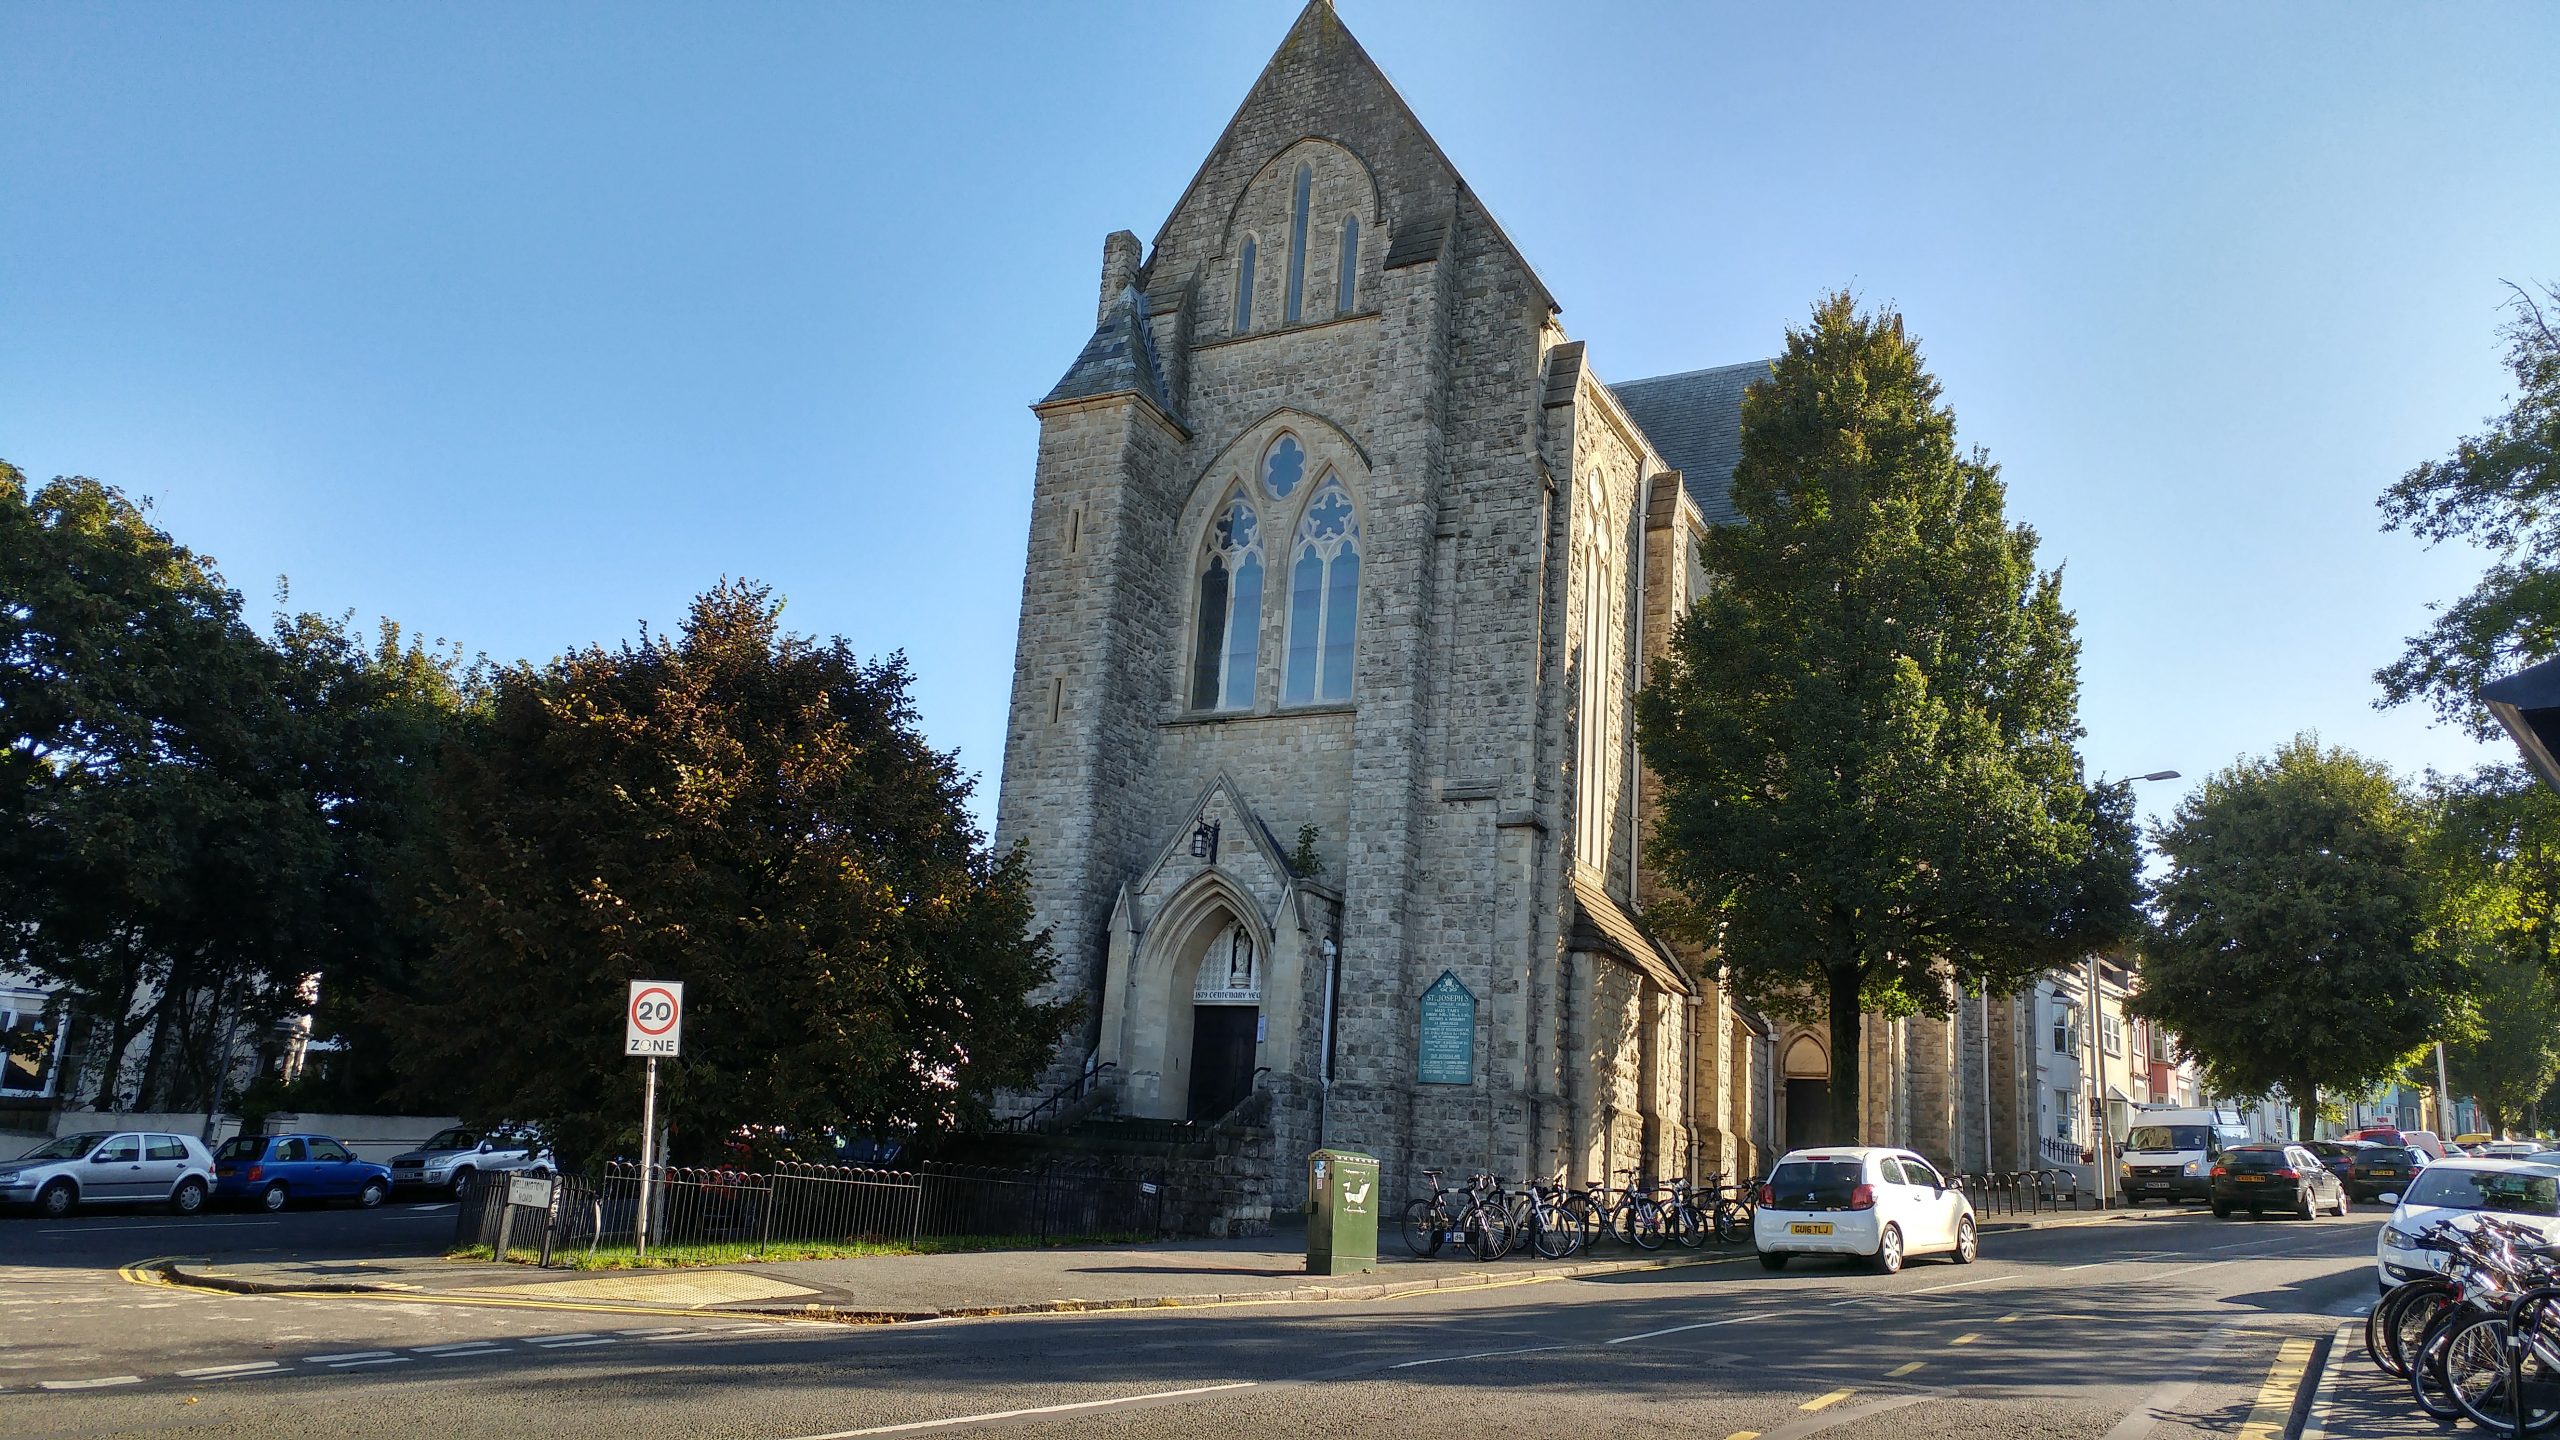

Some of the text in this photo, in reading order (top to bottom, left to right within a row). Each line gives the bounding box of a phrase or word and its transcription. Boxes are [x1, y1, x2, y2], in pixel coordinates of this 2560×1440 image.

[1437, 993, 1470, 1002] JOSEPH'S
[639, 1002, 671, 1021] 20
[1795, 1225, 1829, 1234] GU16 TLJ
[1446, 1232, 1450, 1242] P
